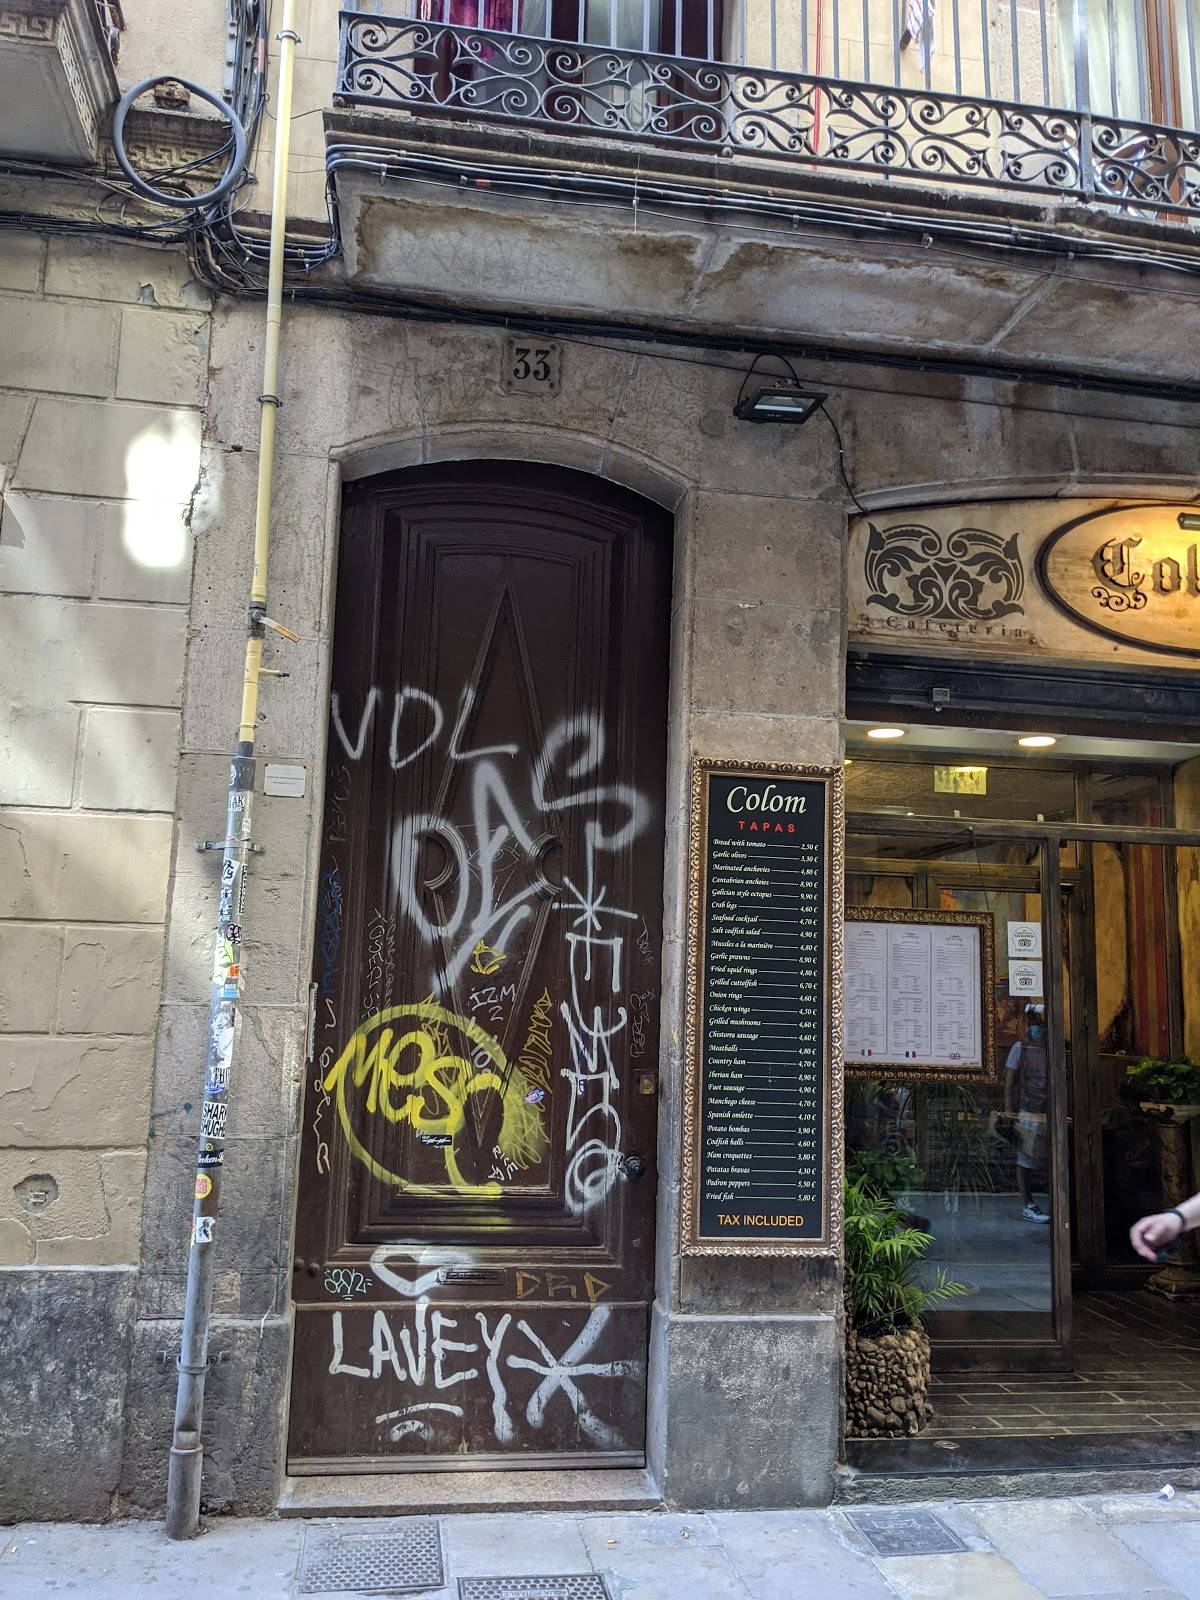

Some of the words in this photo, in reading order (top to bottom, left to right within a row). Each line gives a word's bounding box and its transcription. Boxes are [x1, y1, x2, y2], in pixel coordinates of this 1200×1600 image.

[513, 347, 550, 380] 33
[887, 616, 1023, 637] Cafeteria
[727, 785, 806, 814] Colom
[738, 821, 796, 832] TAPAS
[713, 864, 744, 872] Marinated
[736, 890, 750, 898] style
[726, 902, 737, 910] legs
[711, 914, 736, 922] Seafood
[735, 915, 759, 923] cocktail
[724, 927, 745, 936] codfish
[727, 966, 743, 974] squid
[744, 967, 758, 975] rings
[710, 978, 731, 987] Grilled
[728, 992, 743, 1000] rings
[709, 1004, 732, 1012] Chicken
[733, 1006, 750, 1014] wings
[709, 1018, 730, 1026] Grilled
[709, 1044, 738, 1052] Meatballs
[708, 1058, 732, 1066] Country
[733, 1057, 746, 1065] ham
[708, 1070, 729, 1078] Iberian
[723, 1085, 745, 1093] sausage
[708, 1097, 737, 1106] Manchego
[707, 1111, 731, 1119] Spanish
[706, 1138, 729, 1147] Codfish
[706, 1178, 727, 1186] Padron
[728, 1180, 751, 1188] peppers
[721, 1192, 734, 1202] fish
[718, 1215, 740, 1226] TAX
[744, 1215, 803, 1227] INCLUDED
